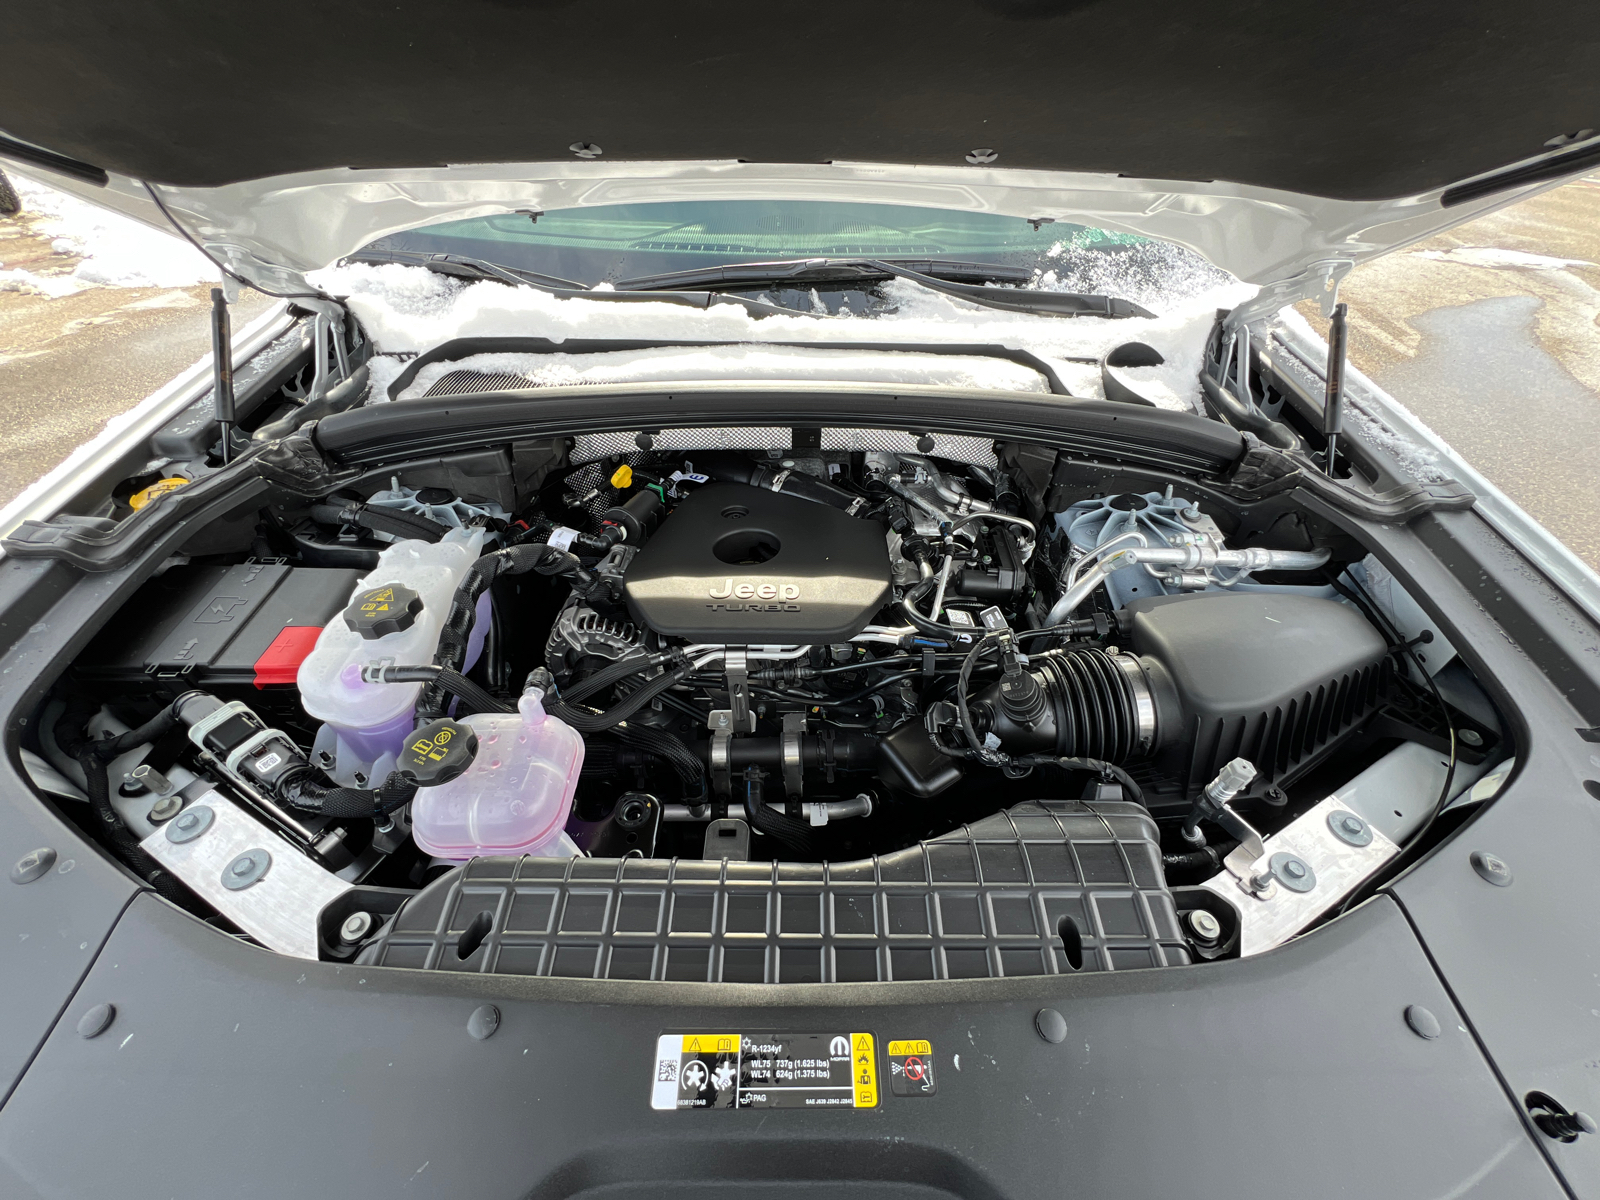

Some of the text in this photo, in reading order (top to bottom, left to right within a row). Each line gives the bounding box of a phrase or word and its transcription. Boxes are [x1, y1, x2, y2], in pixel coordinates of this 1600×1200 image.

[709, 578, 801, 604] Jeep
[706, 603, 801, 612] TURBO
[751, 1044, 782, 1054] R-1234yf
[751, 1060, 830, 1069] WL75 737g (1.625 lbs)
[751, 1070, 830, 1079] WL74 624g (1.375 lbs)
[753, 1094, 767, 1102] PAG
